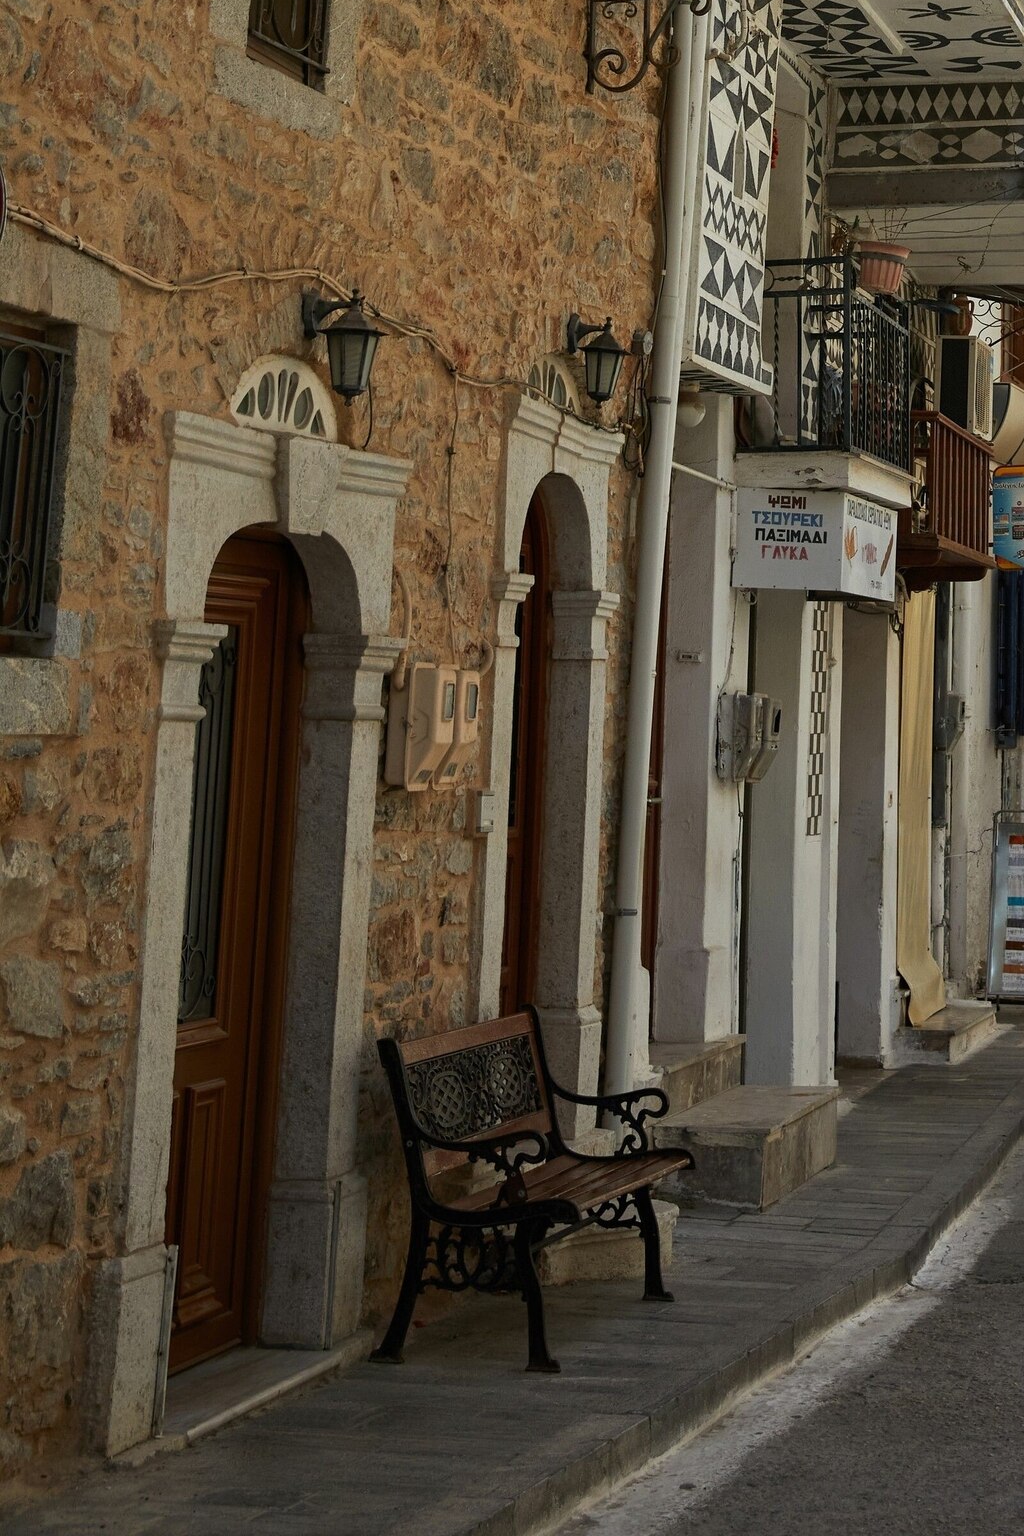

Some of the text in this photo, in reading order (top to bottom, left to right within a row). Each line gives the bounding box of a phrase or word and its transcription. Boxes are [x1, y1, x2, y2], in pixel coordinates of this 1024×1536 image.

[768, 494, 807, 510] ΨΩΜΙ
[751, 510, 824, 527] ΤΣΟΥΡΕΚΙ
[755, 527, 828, 544] ΠΑΞΙΜΑΔΙ
[761, 544, 809, 561] ΓΛΥΚΑ
